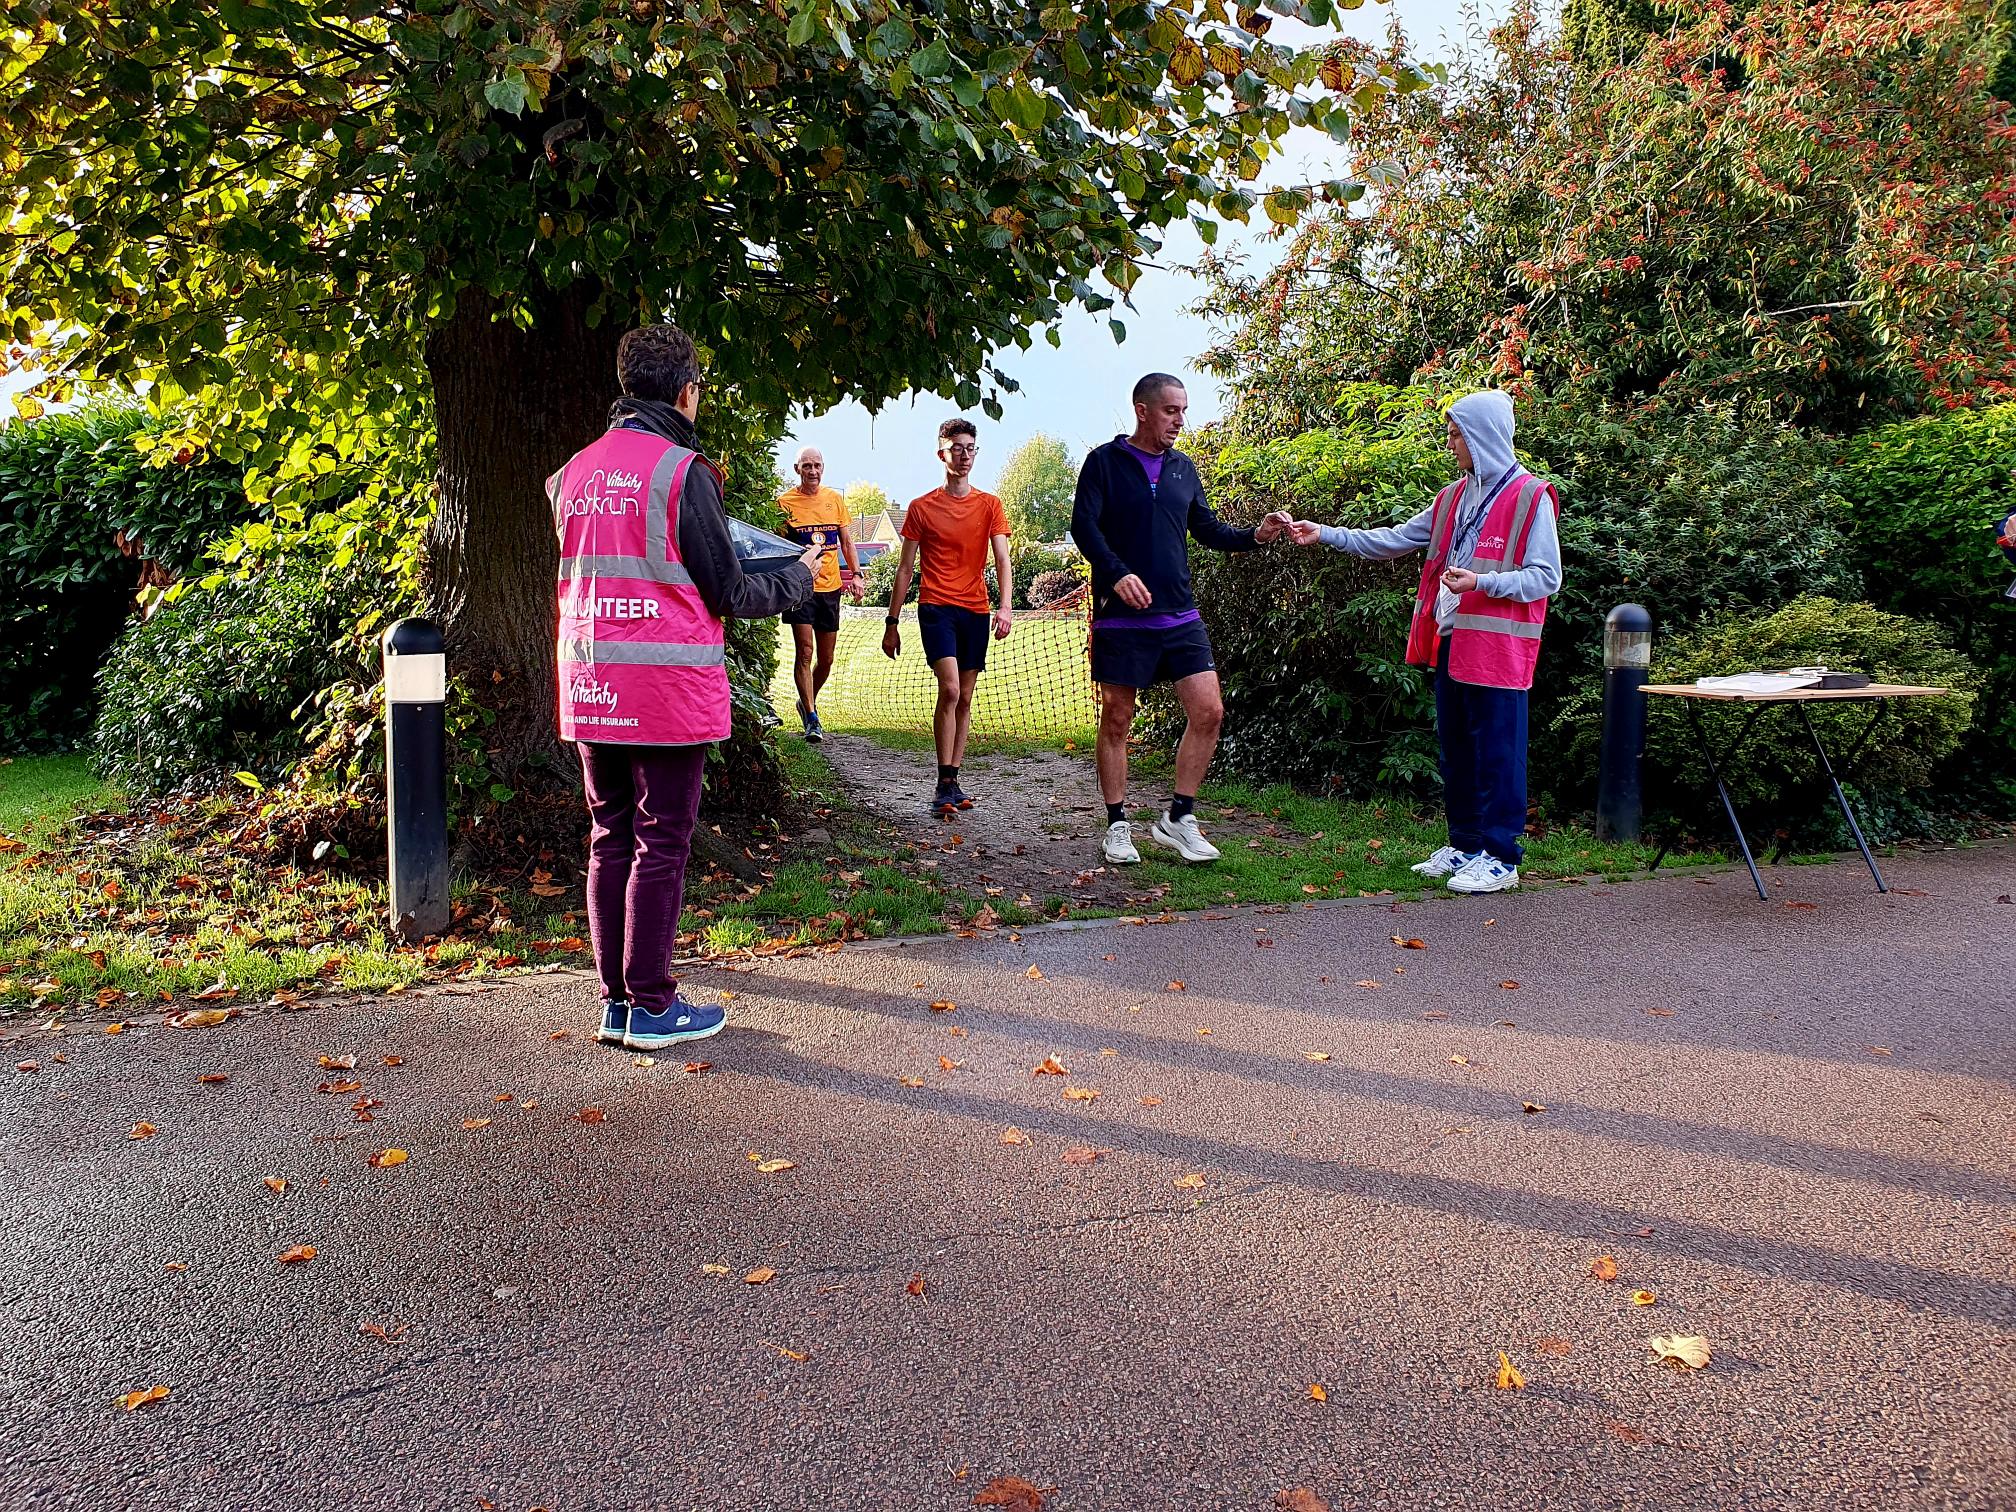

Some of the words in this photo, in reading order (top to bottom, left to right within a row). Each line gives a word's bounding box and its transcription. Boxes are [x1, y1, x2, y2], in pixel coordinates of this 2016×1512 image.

[606, 469, 643, 494] Vitality
[564, 486, 639, 518] parkrun
[1476, 540, 1504, 549] parkrun
[568, 678, 618, 714] Vitality
[574, 715, 588, 725] AND
[588, 716, 601, 726] LIFE
[600, 716, 640, 727] INSURANCE
